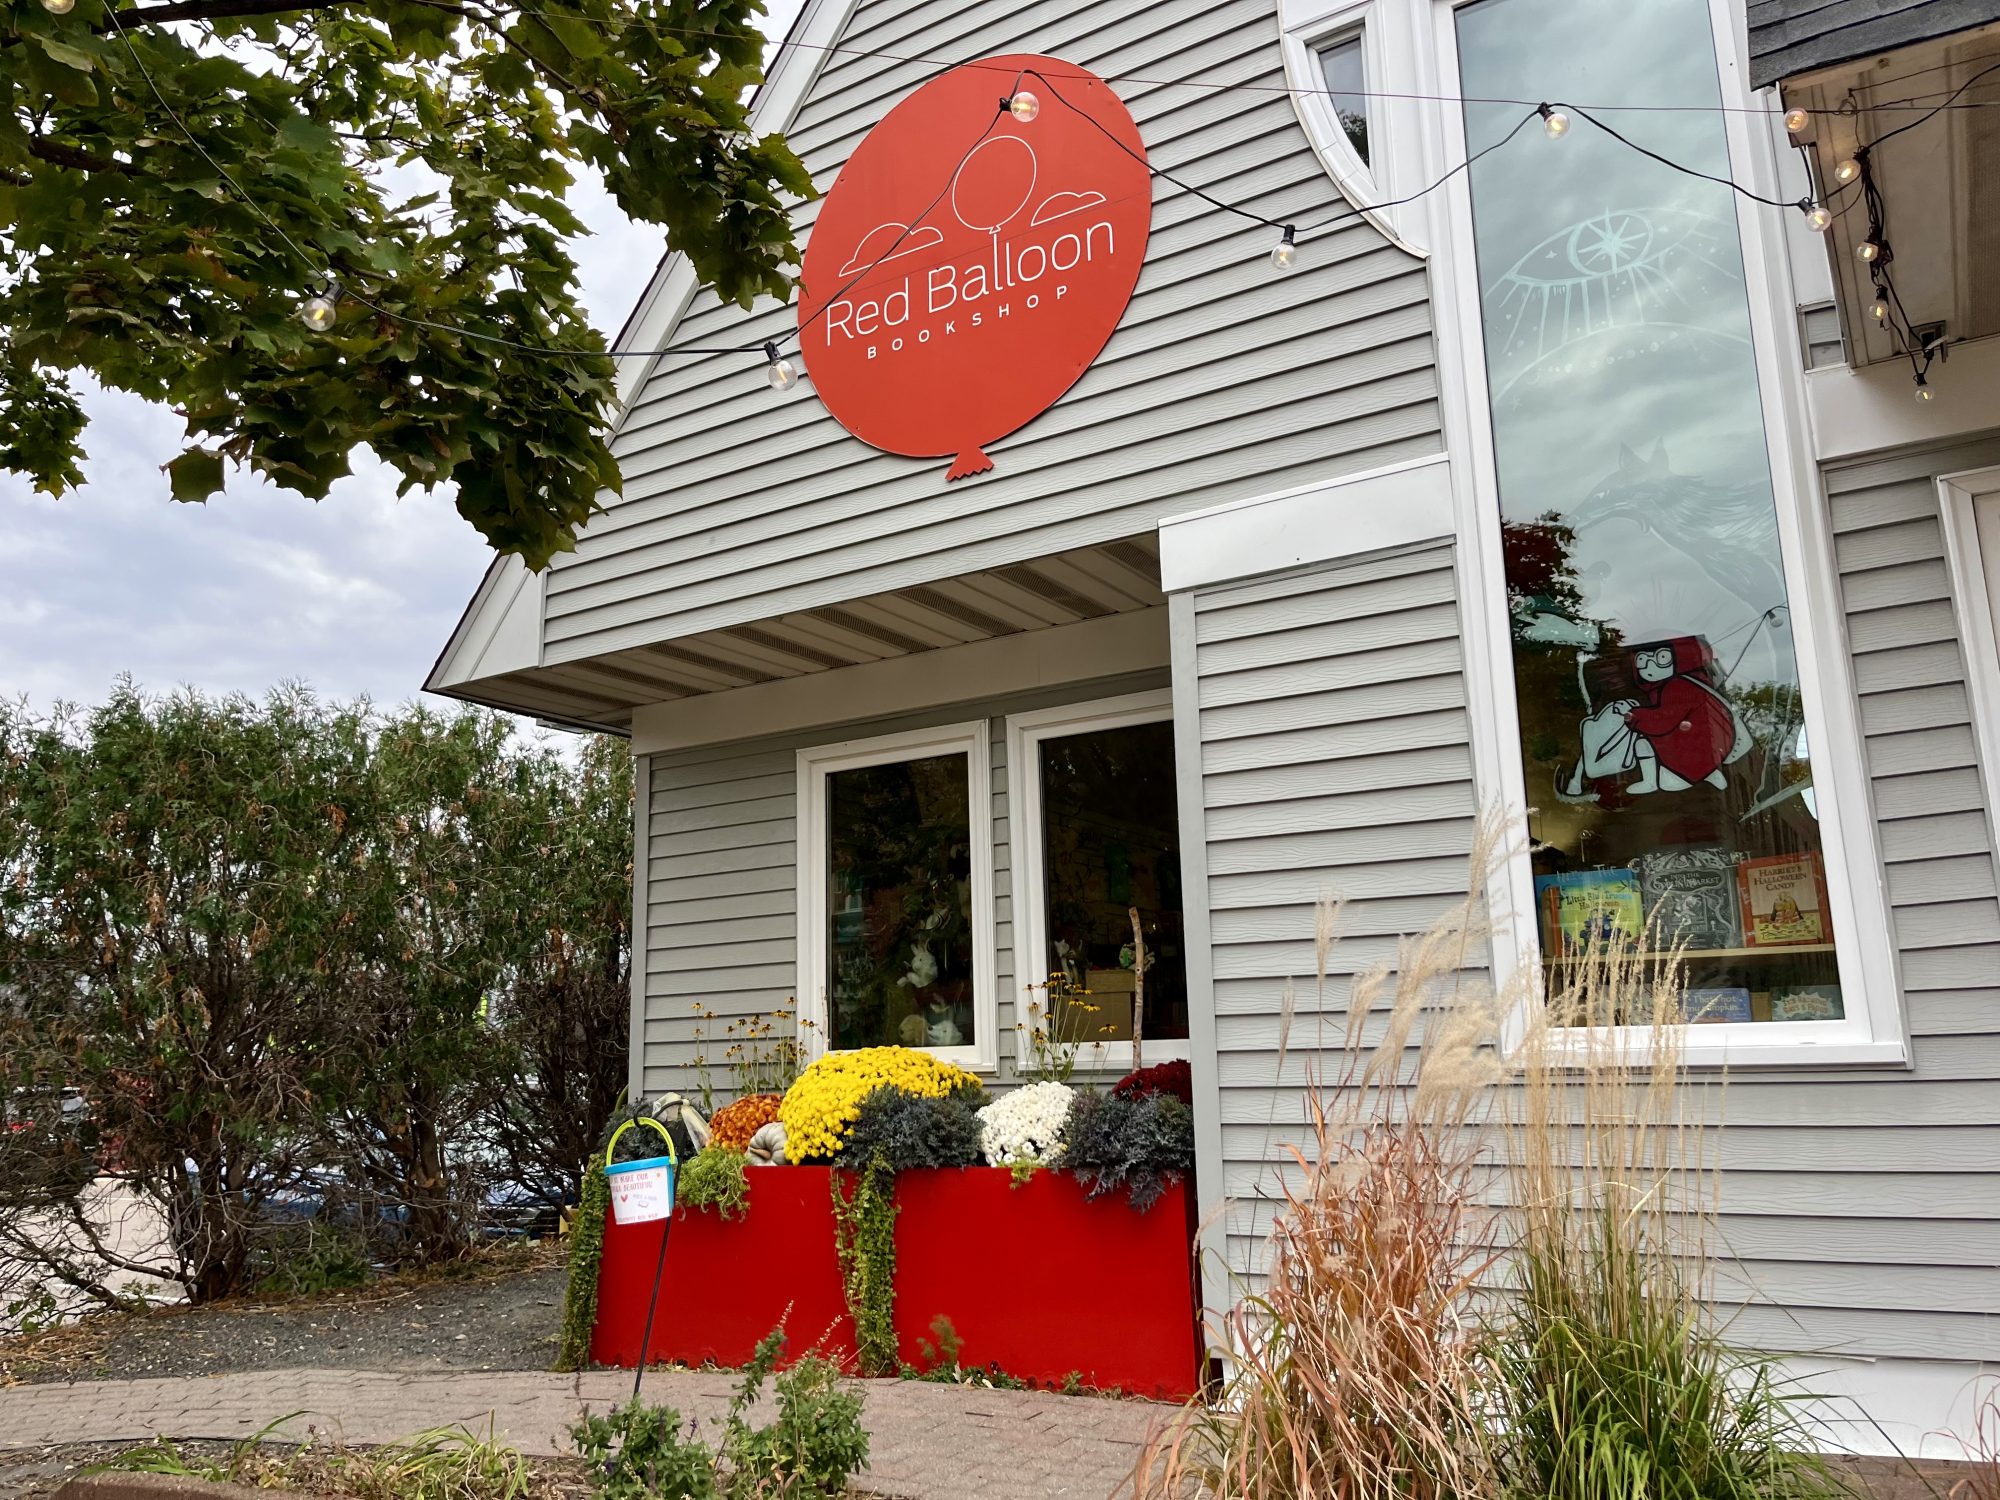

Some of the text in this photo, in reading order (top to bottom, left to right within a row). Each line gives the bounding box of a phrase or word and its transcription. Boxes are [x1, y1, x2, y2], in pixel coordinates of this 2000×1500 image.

[827, 221, 1114, 347] Red Balloon
[867, 285, 1069, 360] BOOKSHOP
[1759, 864, 1803, 877] HARRIET'S
[1754, 872, 1807, 886] HALLOWEEN
[1766, 882, 1796, 892] CANDY
